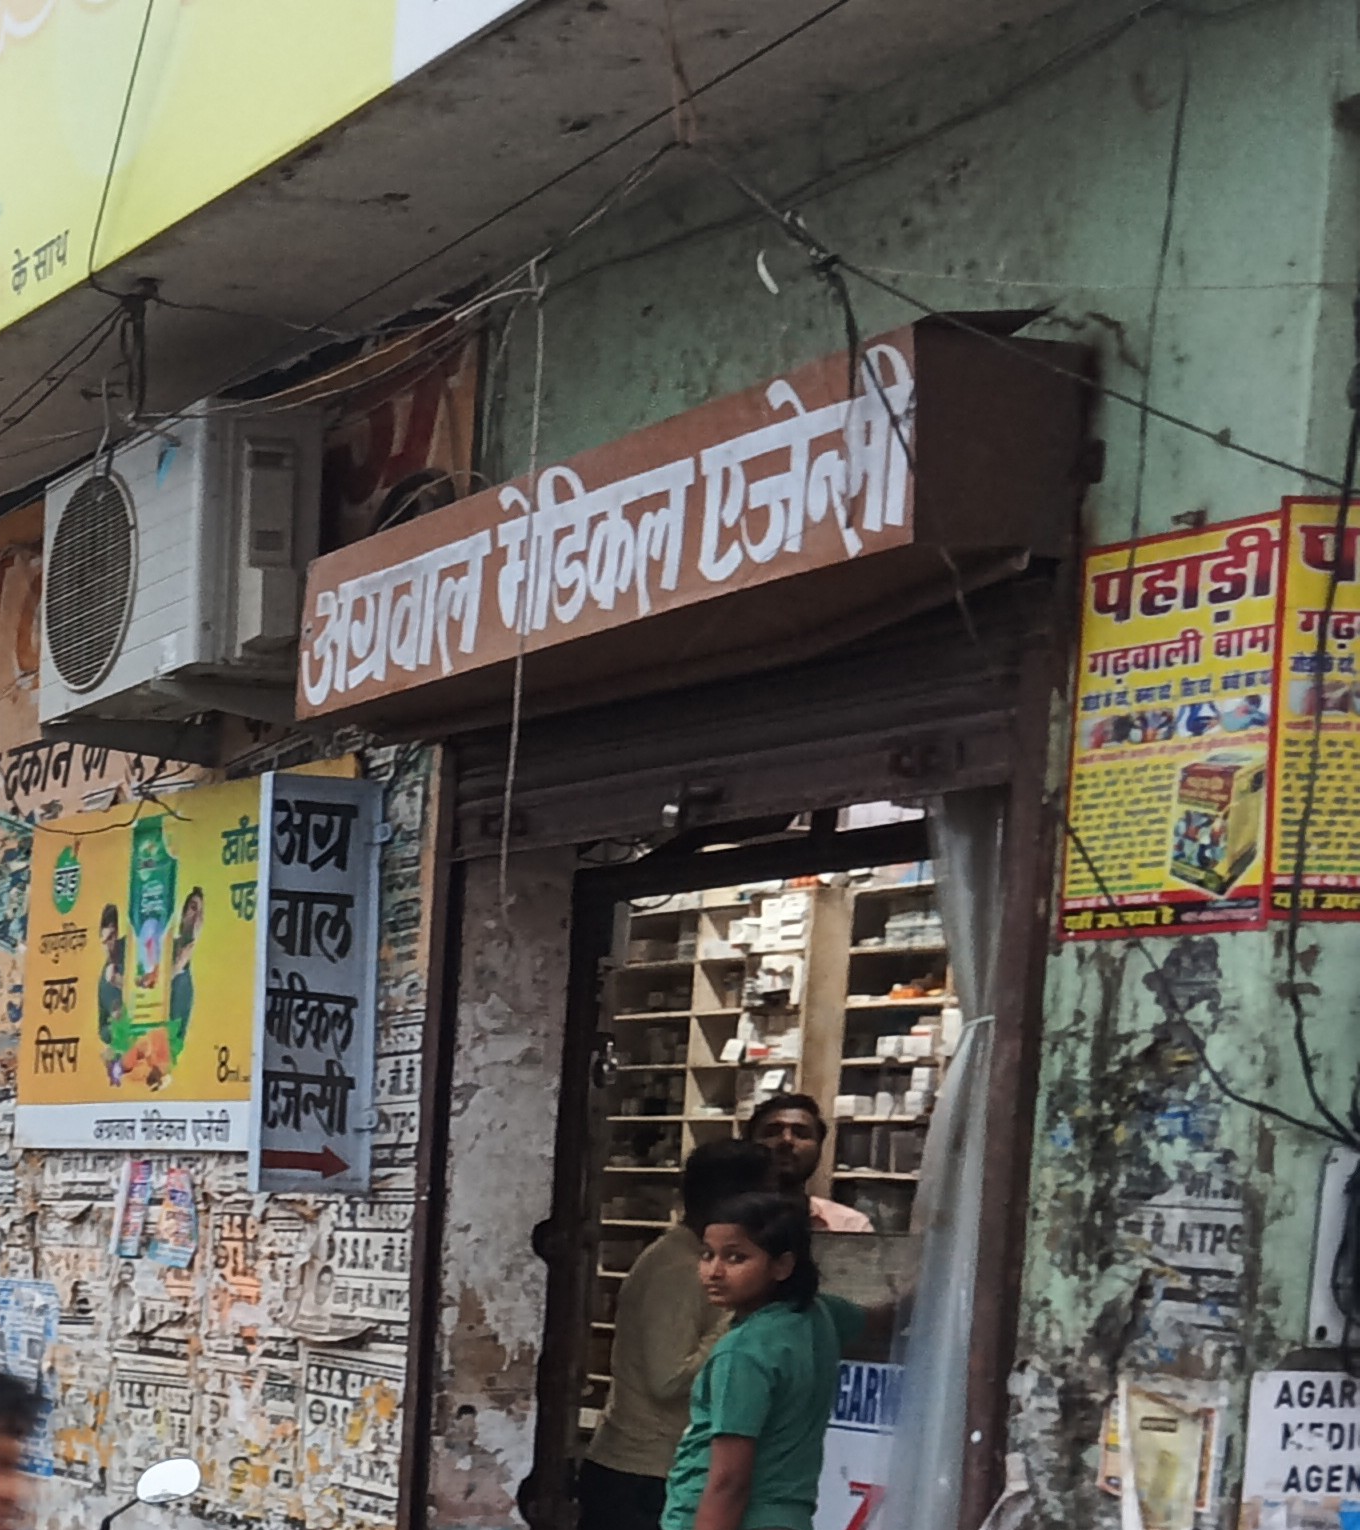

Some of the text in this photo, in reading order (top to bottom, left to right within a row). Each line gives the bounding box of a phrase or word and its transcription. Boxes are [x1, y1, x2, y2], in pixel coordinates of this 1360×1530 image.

[302, 526, 492, 706] अग्रवाल
[496, 464, 696, 636] मेडिकल
[268, 888, 355, 965] वाल
